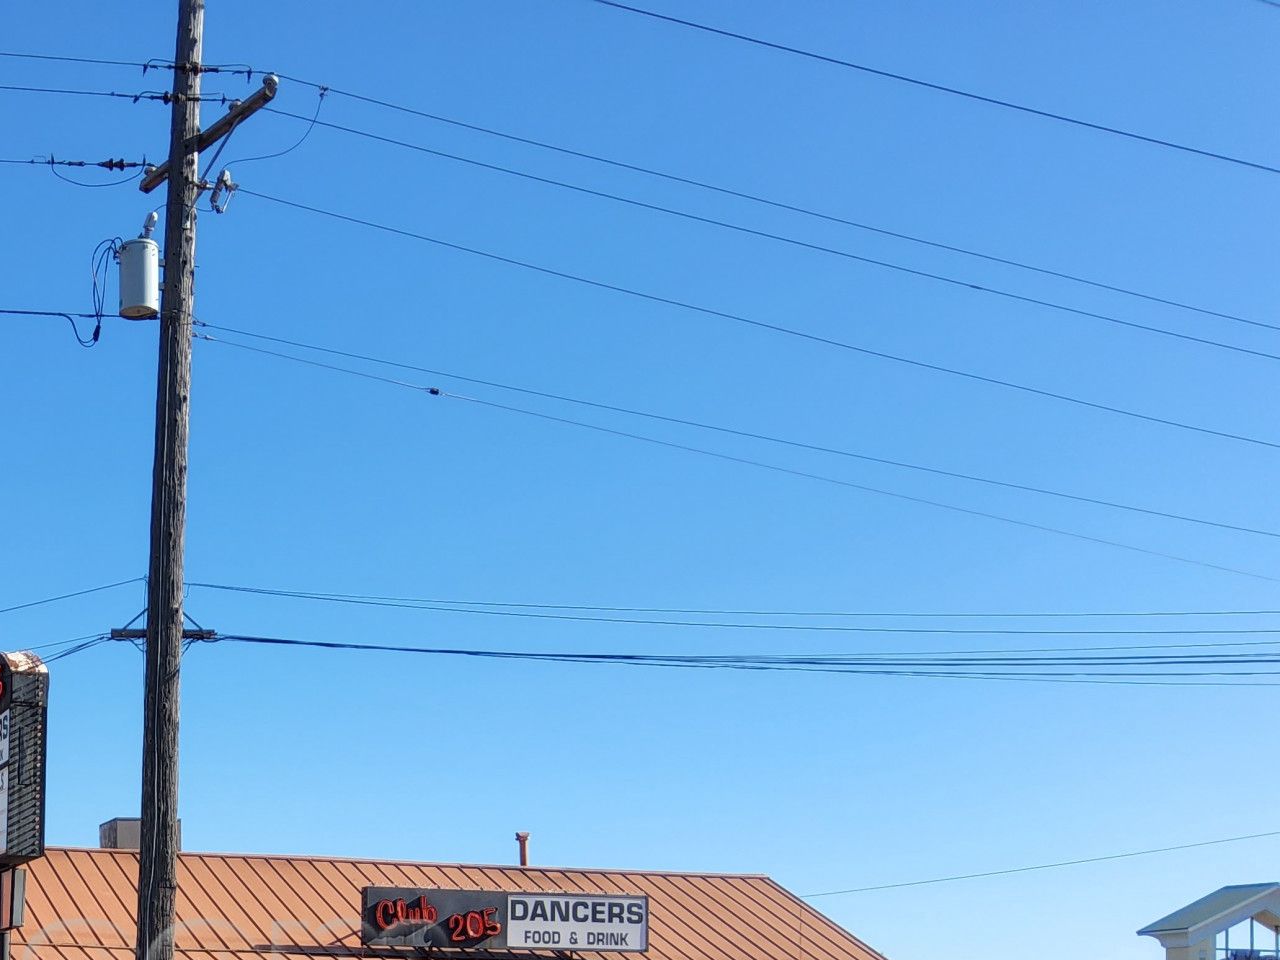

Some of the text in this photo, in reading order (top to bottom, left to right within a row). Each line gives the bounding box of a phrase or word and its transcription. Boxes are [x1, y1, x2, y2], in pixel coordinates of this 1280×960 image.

[376, 895, 502, 942] Club 205
[510, 899, 644, 925] DANCERS
[524, 930, 629, 946] FOOD & DRINK
